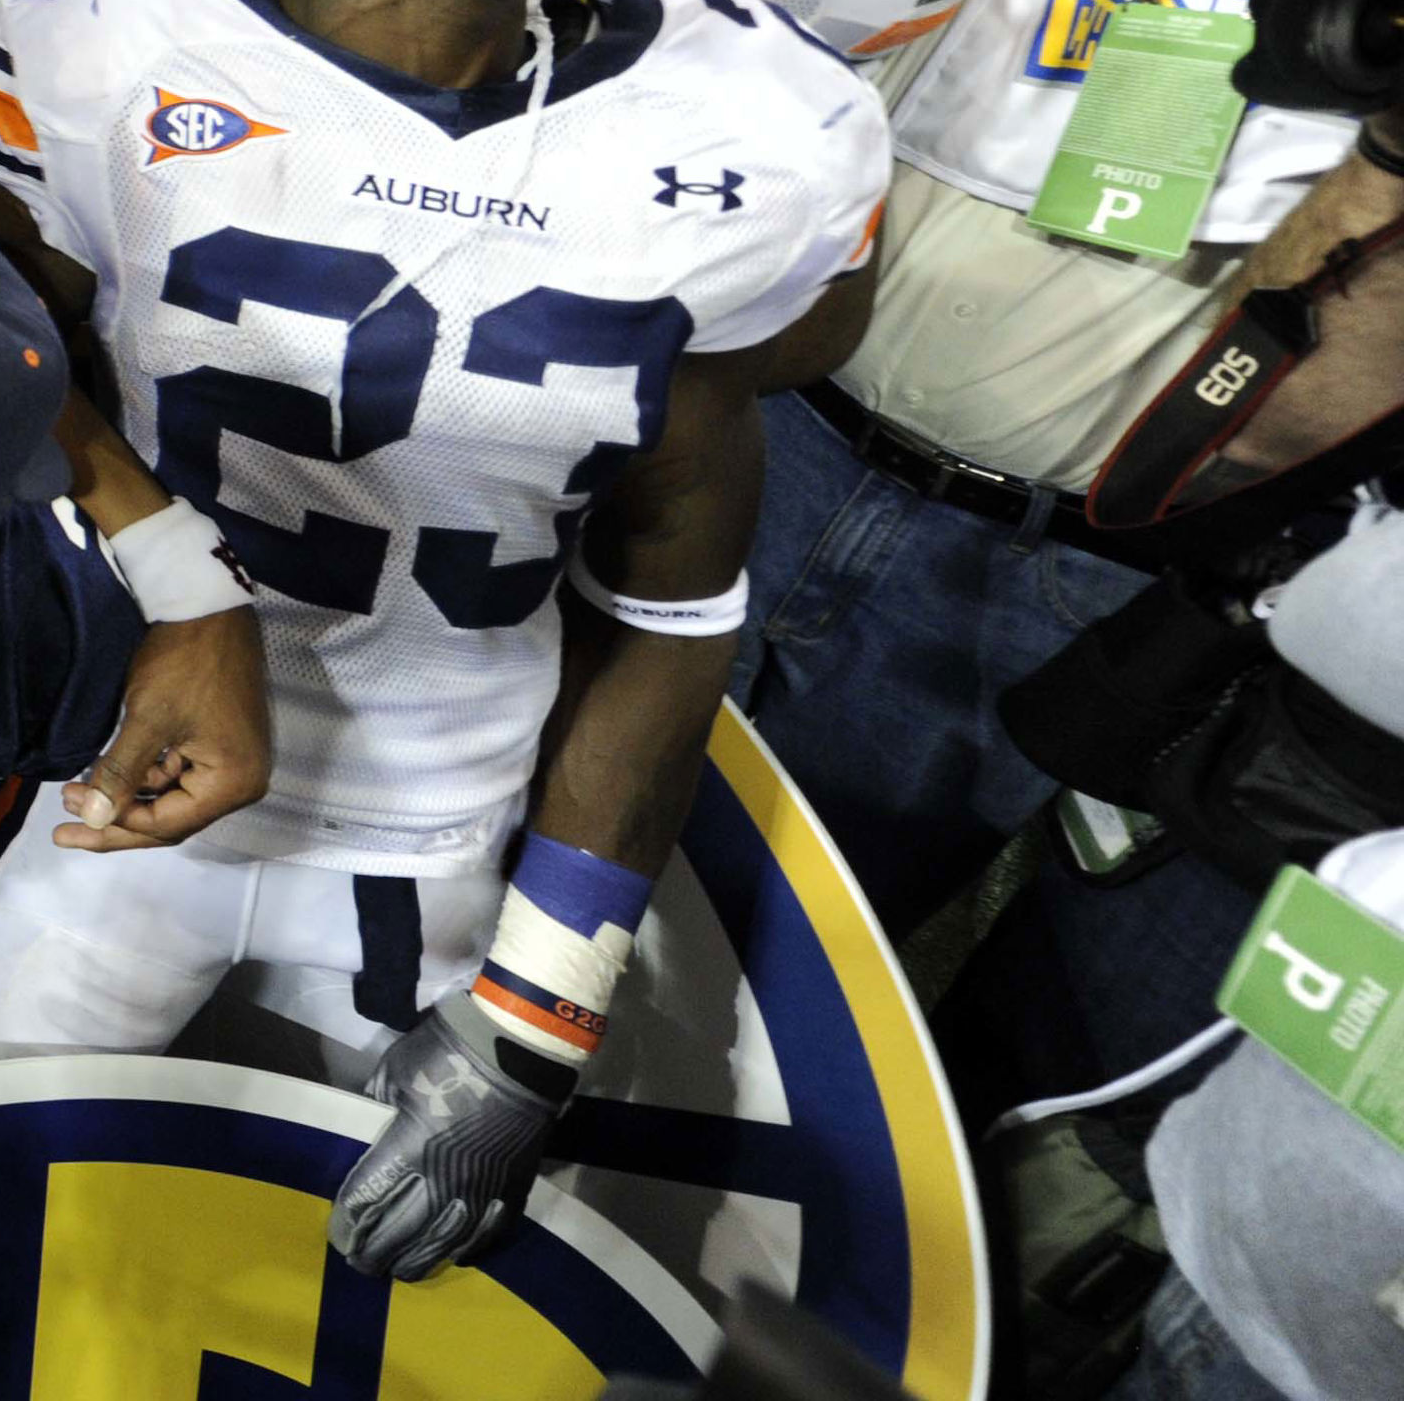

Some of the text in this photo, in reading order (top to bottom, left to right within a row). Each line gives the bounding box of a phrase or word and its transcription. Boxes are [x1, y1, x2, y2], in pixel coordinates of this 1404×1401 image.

[164, 104, 226, 151] SEC
[1092, 163, 1164, 191] PHOTO
[351, 174, 552, 232] AUBURN
[1086, 187, 1143, 235] P
[1195, 345, 1260, 407] EOS
[154, 224, 695, 630] 23
[611, 601, 702, 619] AUBURN
